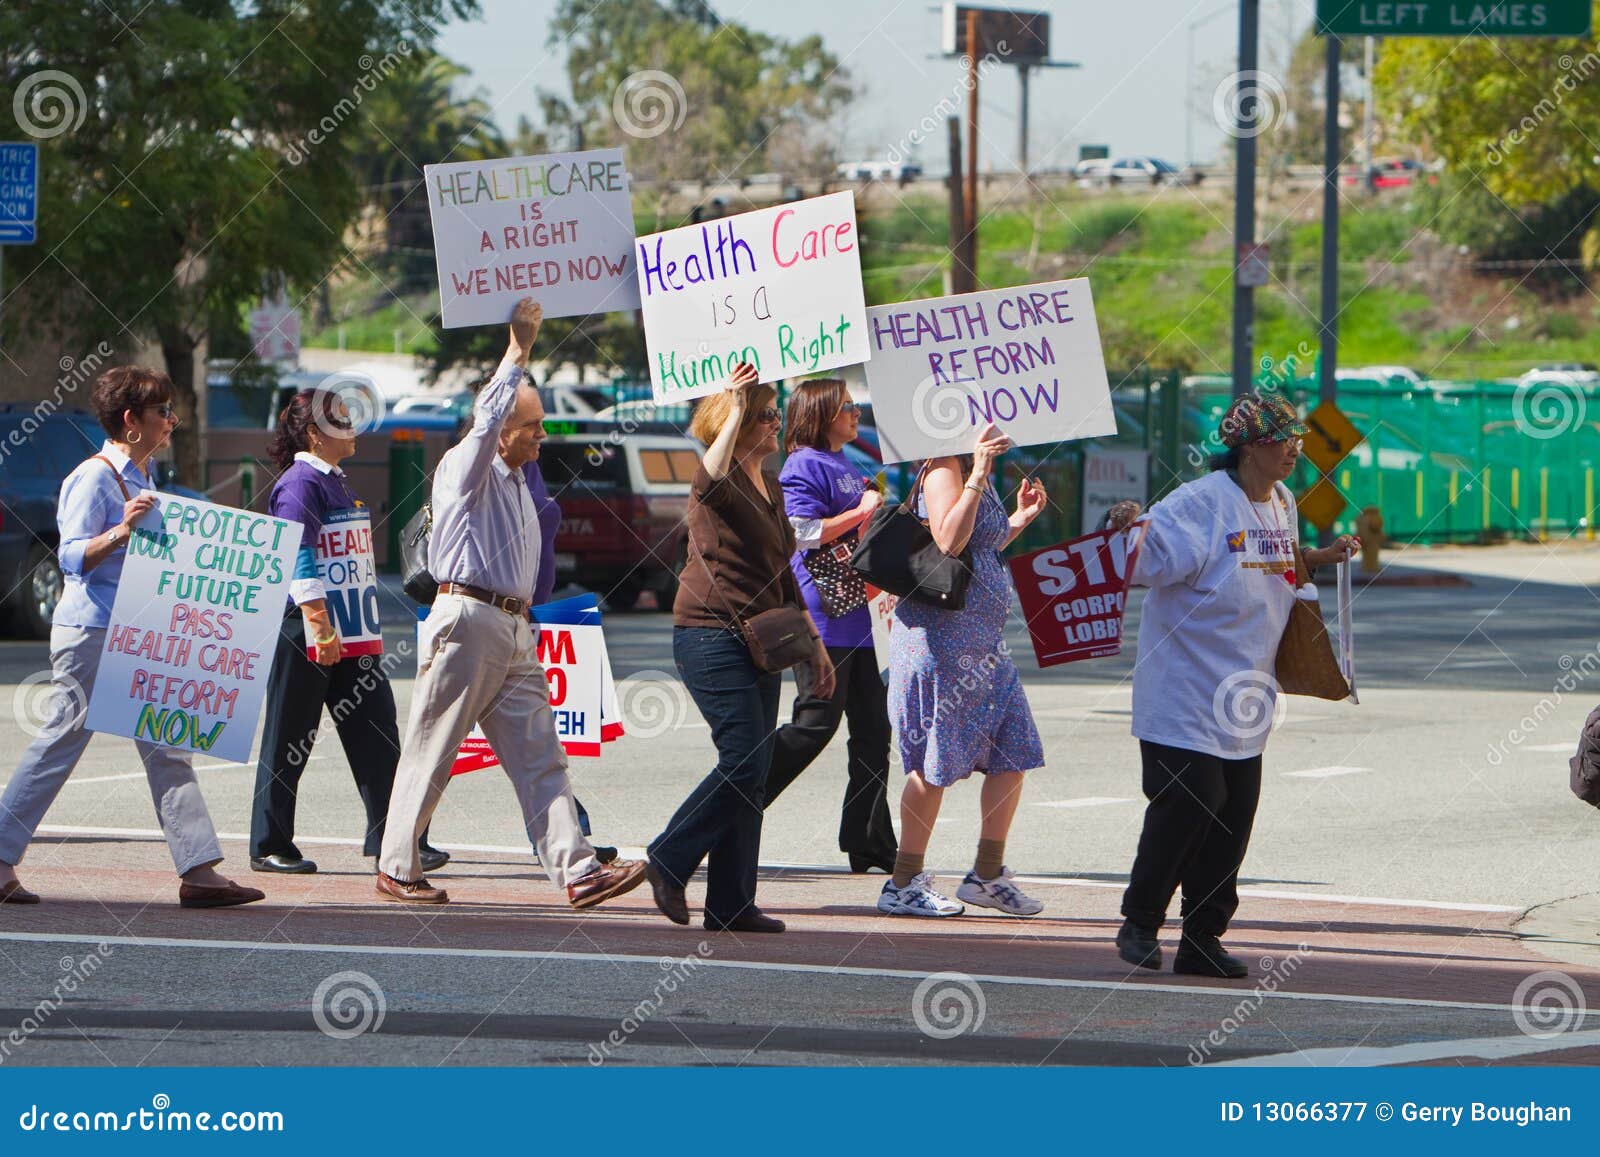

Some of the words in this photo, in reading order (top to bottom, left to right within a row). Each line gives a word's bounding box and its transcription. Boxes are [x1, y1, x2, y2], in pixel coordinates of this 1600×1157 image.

[1360, 4, 1429, 25] LEFT
[1450, 4, 1547, 26] LANES
[436, 161, 624, 207] HEALTHCARE
[520, 202, 543, 221] IS
[480, 230, 495, 252] A
[504, 221, 578, 249] RIGHT
[640, 220, 757, 295] Health
[773, 210, 854, 268] Care
[452, 269, 490, 295] WE
[495, 261, 561, 291] NEED
[568, 255, 628, 282] NOW
[712, 295, 737, 327] is
[753, 286, 771, 320] a
[873, 302, 989, 350] HEALTH
[998, 290, 1074, 330] CARE
[658, 346, 761, 394] Human
[778, 314, 851, 371] Right
[928, 336, 1056, 386] REFORM
[967, 379, 1058, 425] NOW
[161, 501, 288, 551] PROTECT
[128, 527, 178, 563] YOUR
[195, 544, 283, 584] CHILD'S
[157, 570, 262, 613] FUTURE
[170, 603, 234, 640] PASS
[1064, 618, 1121, 644] LOBB
[108, 625, 191, 667] HEALTH
[199, 644, 260, 680] CARE
[130, 669, 239, 719] REFORM
[135, 703, 227, 751] NOW
